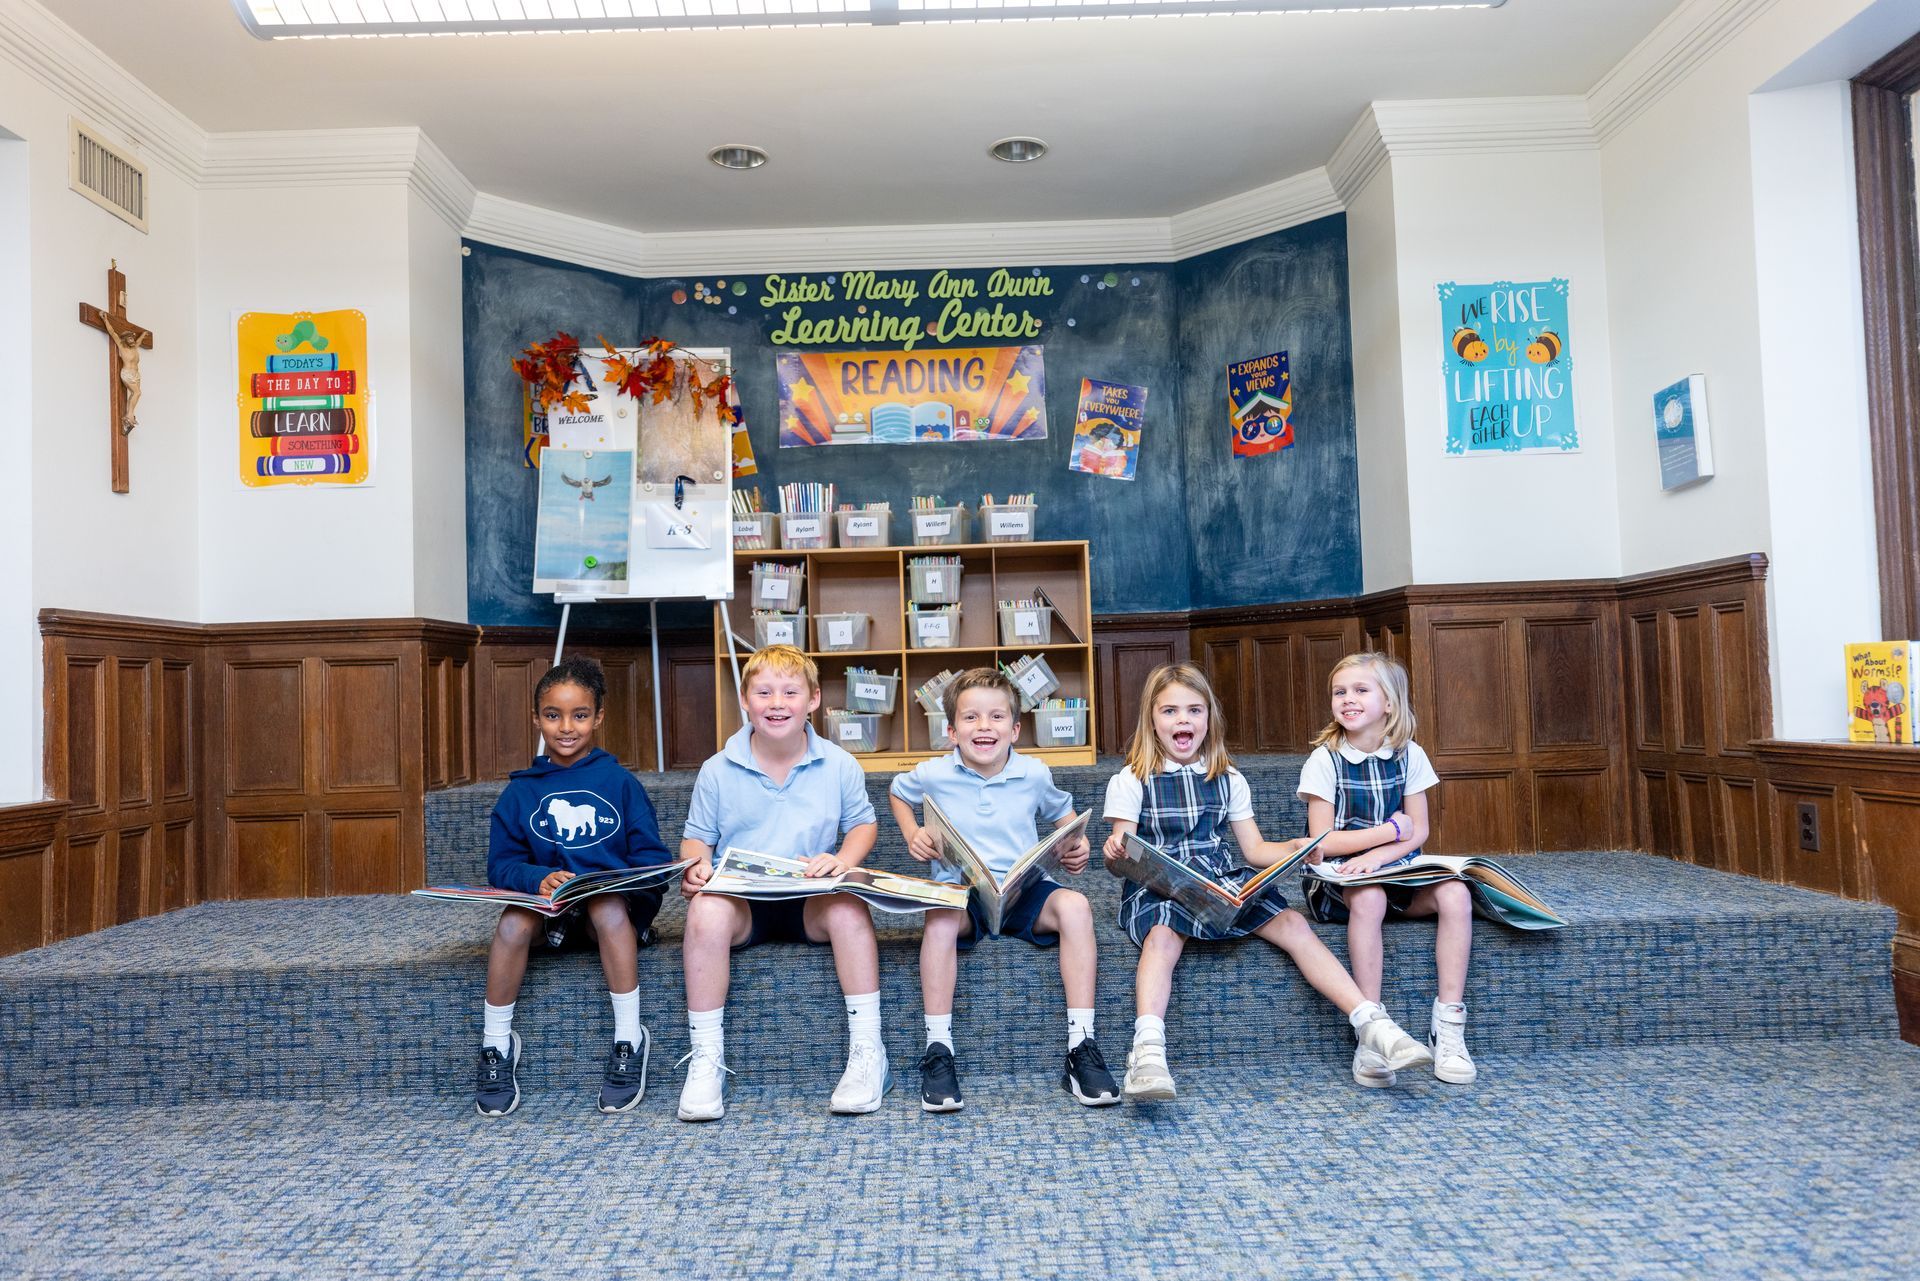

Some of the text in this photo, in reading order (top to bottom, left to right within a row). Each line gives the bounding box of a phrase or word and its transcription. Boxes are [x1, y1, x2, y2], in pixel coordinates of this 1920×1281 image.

[760, 268, 1053, 307] Sister Mary Ann Dunn
[1462, 286, 1551, 325] WE RISE
[770, 298, 1039, 352] Learning Center
[1493, 325, 1519, 366] by
[282, 358, 323, 369] TODAY'S
[1238, 355, 1279, 376] EXPANDS
[267, 377, 341, 391] THE DAY TO
[842, 357, 984, 395] READING
[1246, 375, 1275, 392] VIEWS
[1454, 366, 1564, 403] LIFTING
[1102, 385, 1128, 399] TAKES
[558, 415, 604, 425] WELCOME
[1084, 401, 1140, 419] EVERYWHERE
[1470, 404, 1509, 430] EACH
[1513, 403, 1552, 437] UP
[274, 412, 330, 433] LEARN
[1472, 419, 1510, 445] OTHER
[288, 440, 342, 450] SOMETHING
[294, 460, 314, 470] NEW
[1853, 651, 1871, 662] What
